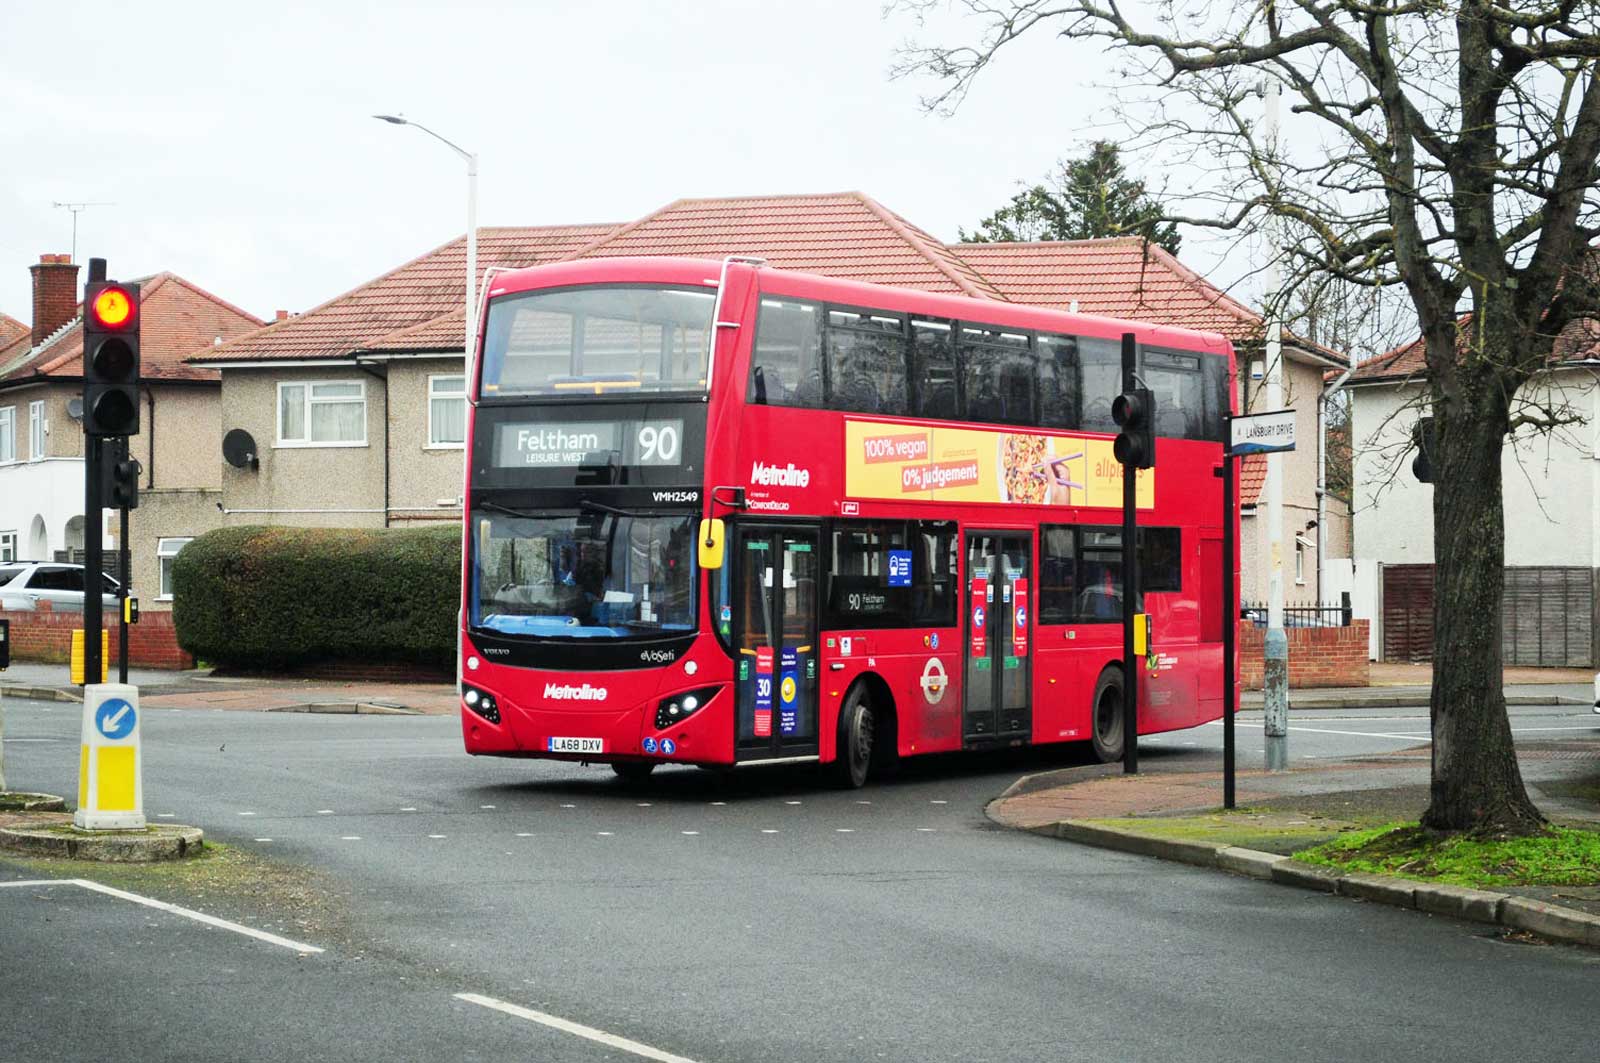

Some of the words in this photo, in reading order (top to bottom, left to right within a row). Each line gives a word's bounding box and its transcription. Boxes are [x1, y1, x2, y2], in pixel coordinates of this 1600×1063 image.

[517, 429, 598, 450] Feltham
[1246, 426, 1275, 438] LANSBURY
[1276, 423, 1293, 435] DRIVE
[638, 426, 676, 461] 90
[864, 439, 894, 457] 100%
[896, 439, 926, 459] vegan
[526, 452, 560, 463] LEISURE
[562, 452, 587, 462] WEST
[751, 461, 809, 488] Metroline
[903, 468, 920, 487] 0%
[921, 464, 977, 490] judgement
[653, 492, 698, 502] VMH2549
[848, 593, 860, 610] 90
[543, 683, 607, 701] Metroline
[757, 678, 771, 697] 30
[554, 739, 580, 750] LA68
[582, 740, 601, 751] DXV
